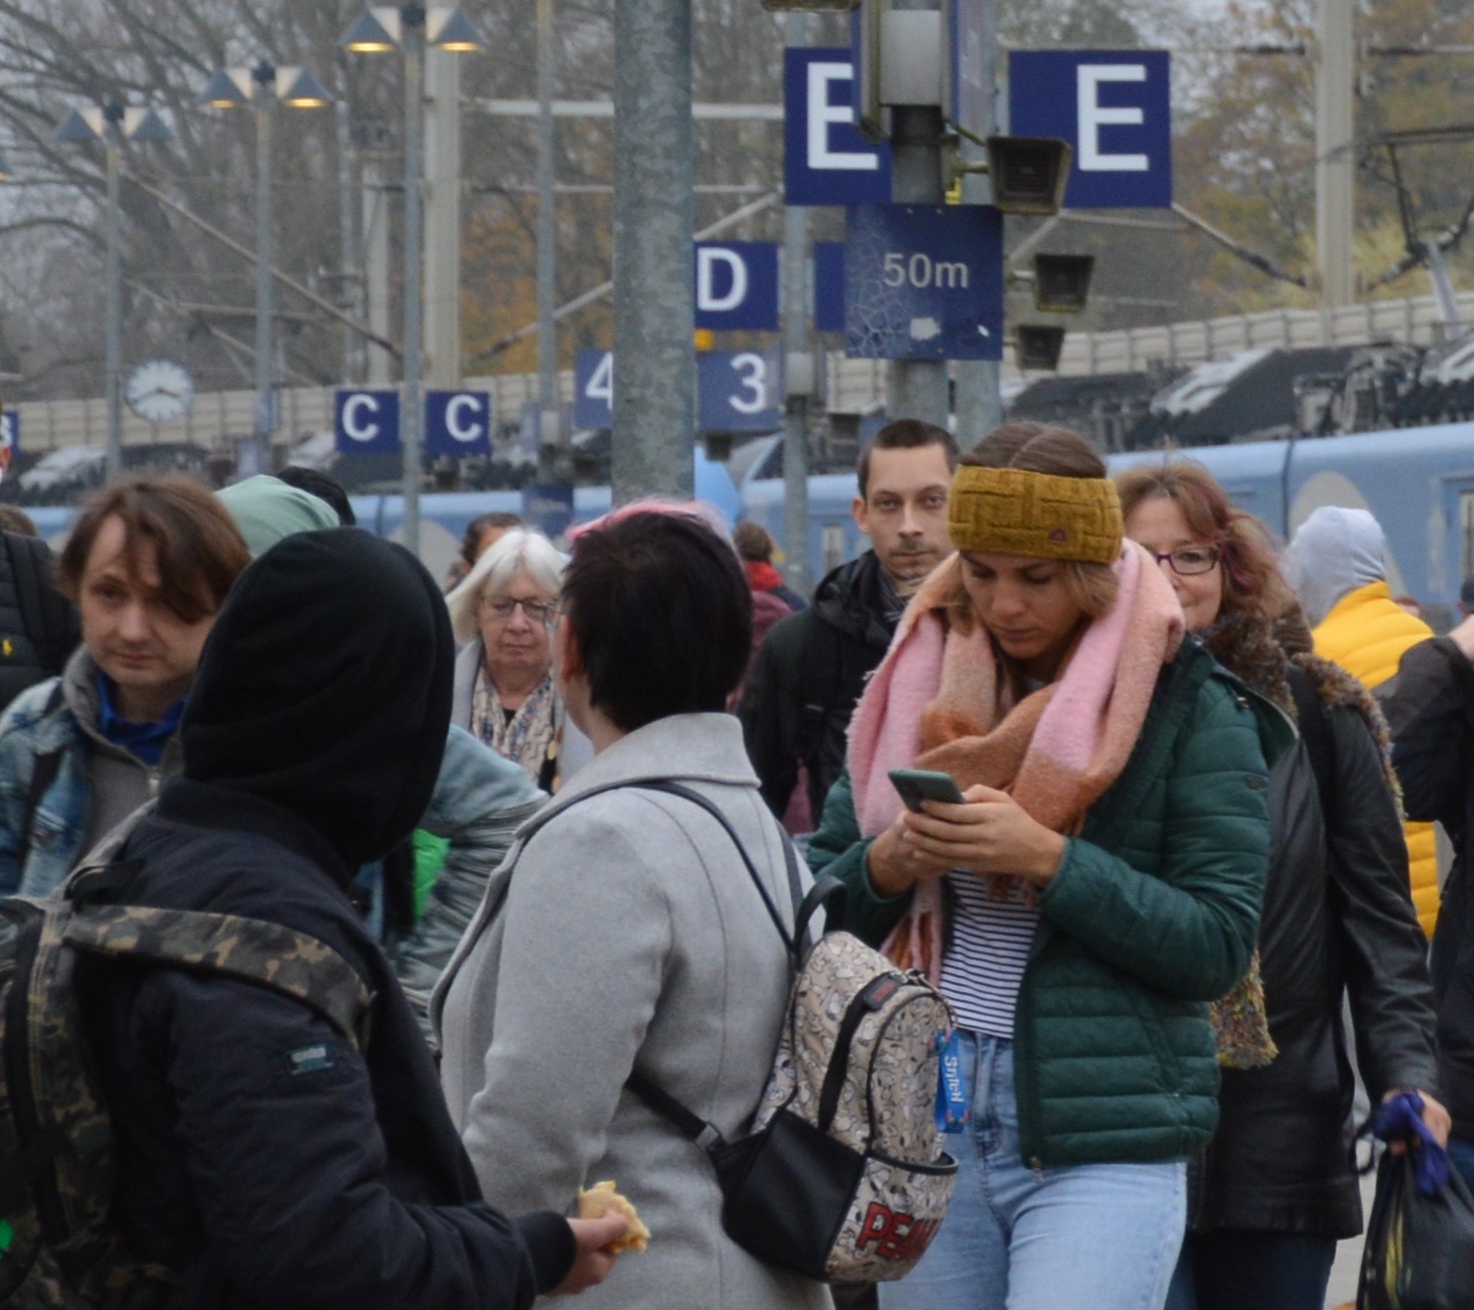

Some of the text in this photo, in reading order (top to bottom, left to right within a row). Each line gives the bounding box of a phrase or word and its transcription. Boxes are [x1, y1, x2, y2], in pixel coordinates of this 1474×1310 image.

[807, 62, 879, 170] E
[1076, 64, 1149, 171] E
[696, 247, 748, 312] D
[882, 253, 970, 289] 50m
[585, 352, 613, 411] 4
[728, 352, 767, 414] 3
[341, 393, 380, 441] C
[445, 393, 482, 442] C
